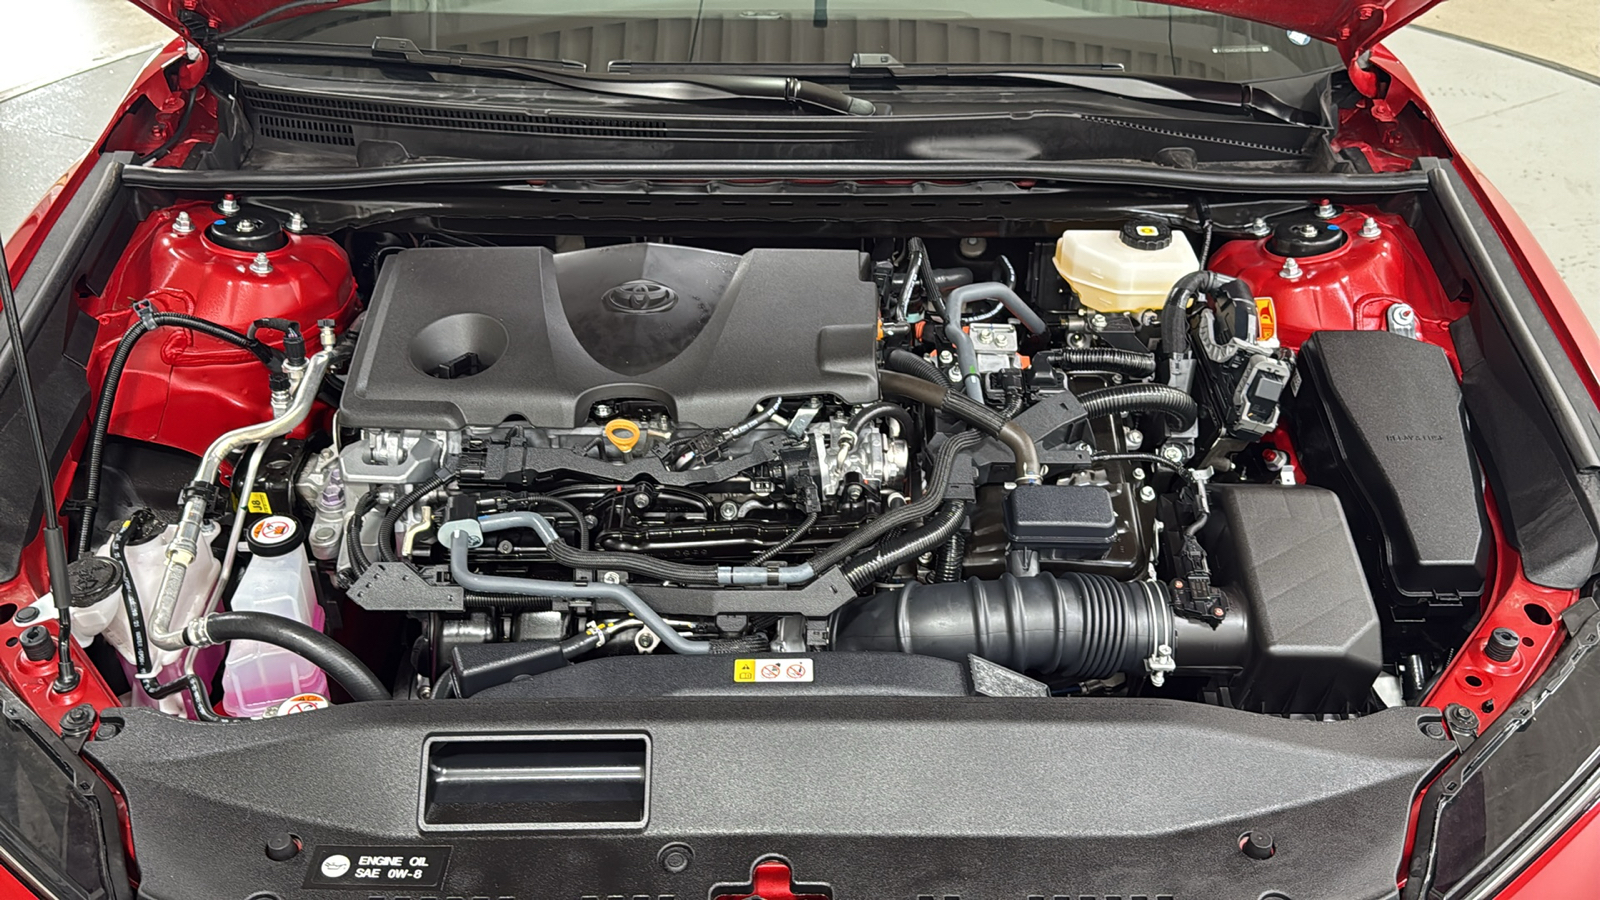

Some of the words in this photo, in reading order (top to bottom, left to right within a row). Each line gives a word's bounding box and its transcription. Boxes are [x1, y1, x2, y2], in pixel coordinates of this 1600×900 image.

[358, 856, 404, 866] ENGINE
[409, 856, 429, 867] OIL
[355, 868, 381, 878] SAE
[387, 869, 423, 879] 0W-8
